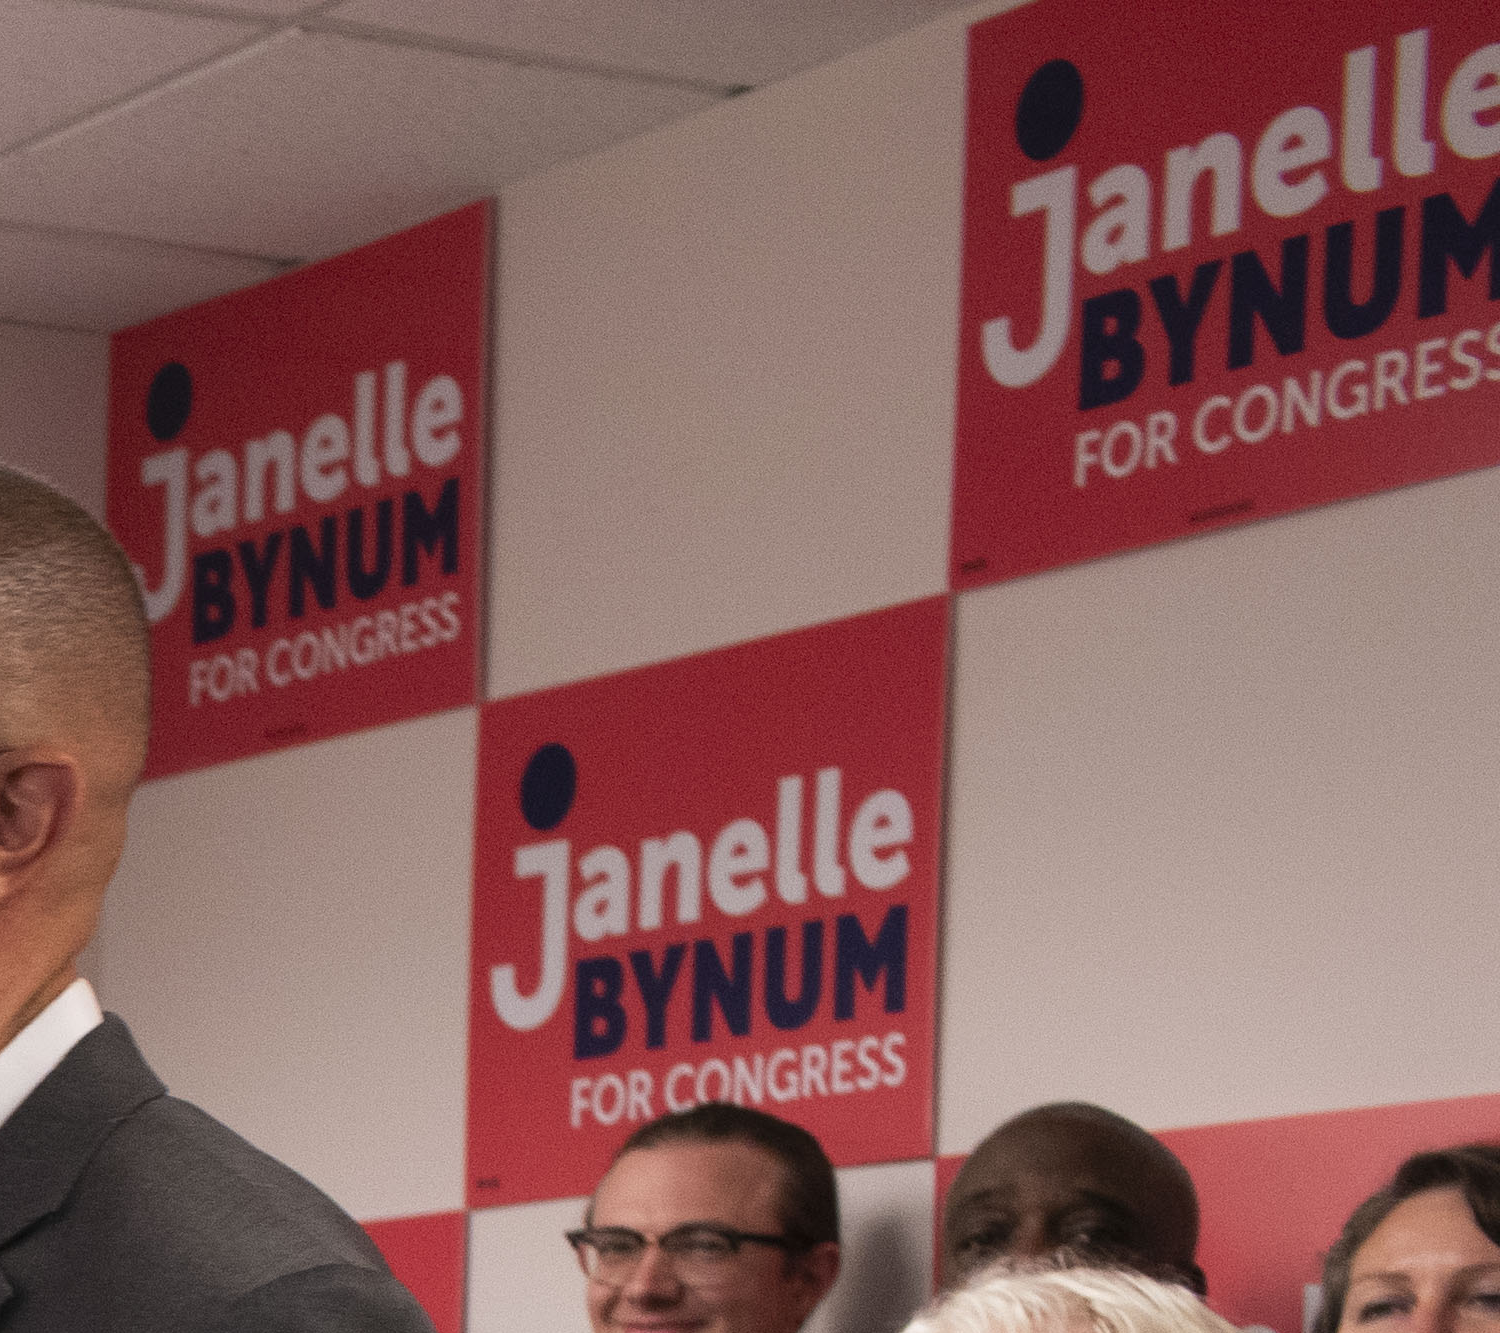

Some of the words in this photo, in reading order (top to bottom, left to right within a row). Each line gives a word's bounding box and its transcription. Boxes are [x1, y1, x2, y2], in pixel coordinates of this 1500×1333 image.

[982, 26, 1500, 388] Janelle
[1078, 176, 1500, 412] BYNUM
[136, 360, 464, 623] Janelle
[1073, 411, 1179, 487] FOR
[191, 477, 460, 645] BYNUM
[190, 648, 259, 704] FOR
[265, 593, 460, 687] CONGRESS
[490, 742, 914, 1031] Janelle
[573, 904, 909, 1061] BYNUM
[570, 1068, 655, 1129] FOR
[662, 1032, 907, 1116] CONGRESS
